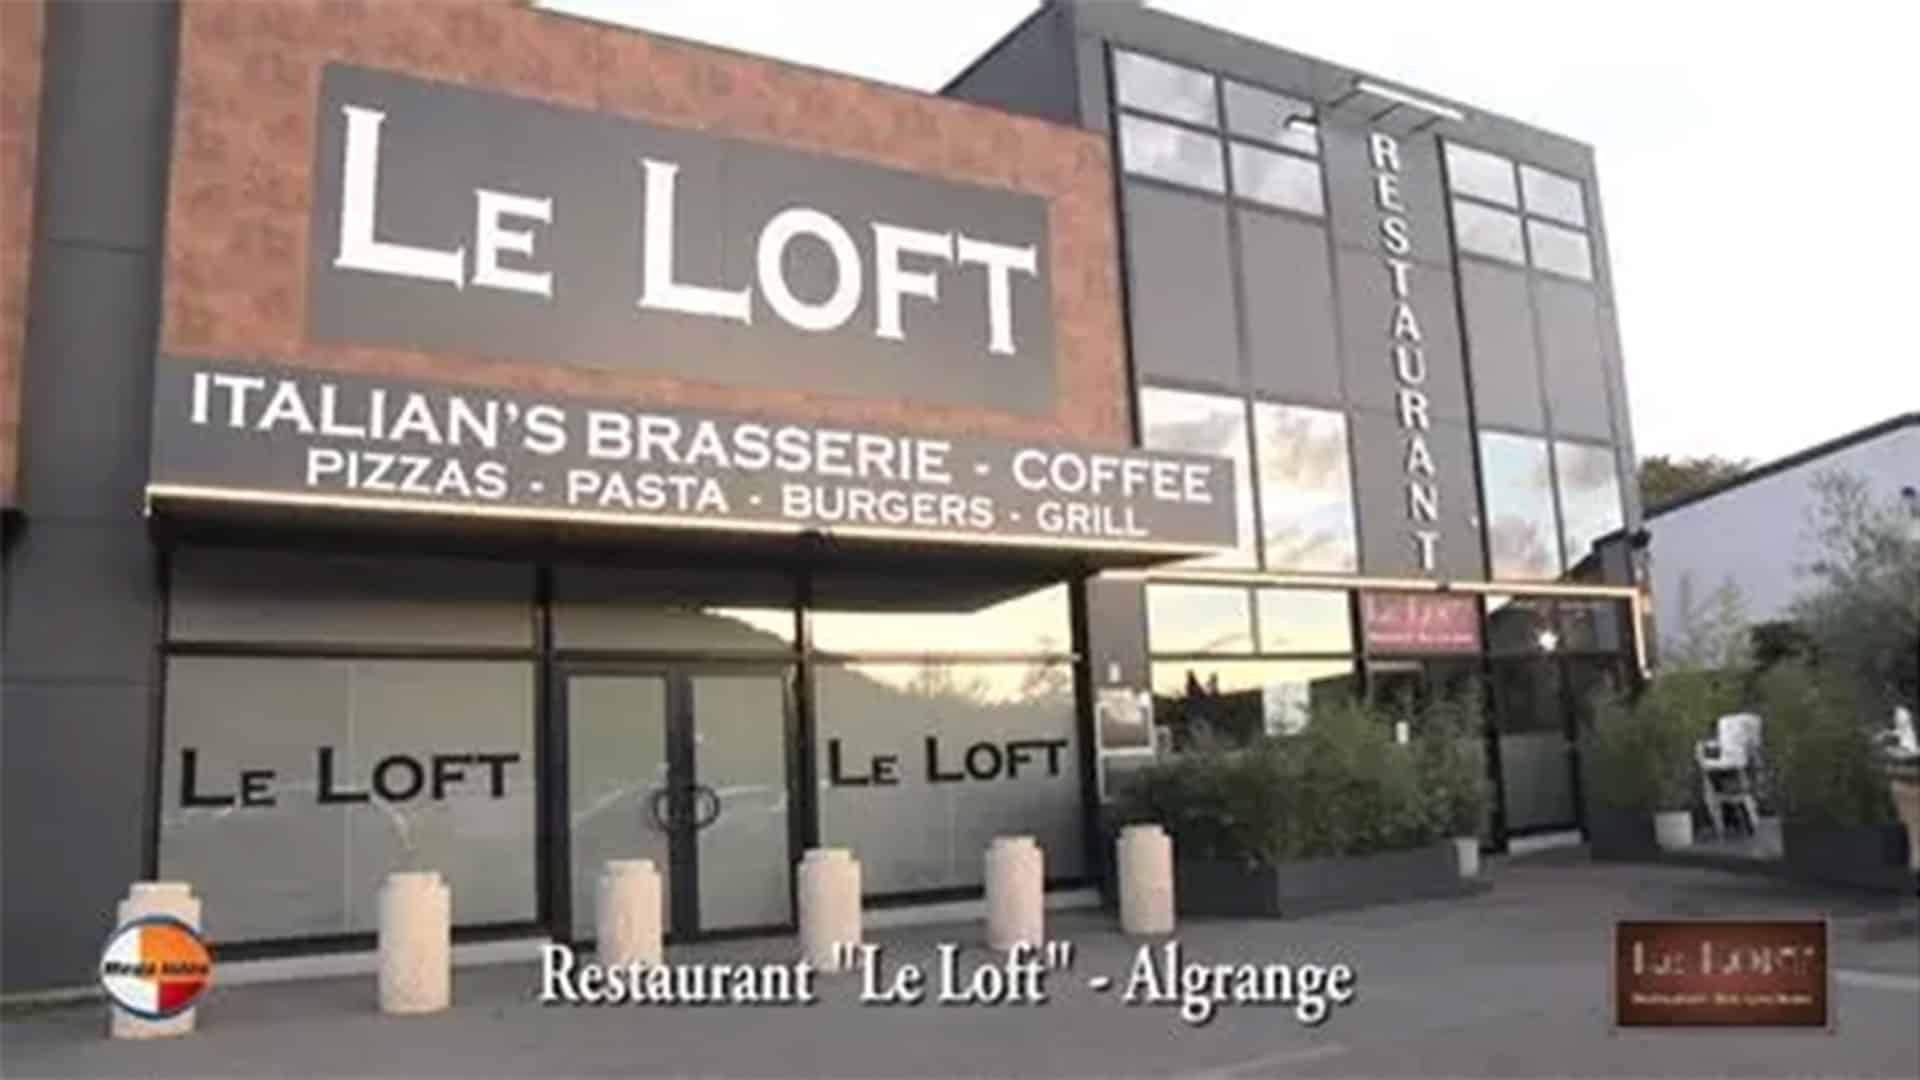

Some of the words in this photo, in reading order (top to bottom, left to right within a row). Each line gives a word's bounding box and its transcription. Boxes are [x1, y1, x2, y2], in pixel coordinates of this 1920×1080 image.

[637, 157, 1038, 357] LOFT
[1370, 131, 1440, 571] RESTAURANT
[190, 372, 568, 455] ITALIAN'S
[586, 409, 954, 486] BRASSERIE
[1010, 447, 1214, 505] COFFEE
[306, 448, 508, 500] PIZZAS
[566, 468, 731, 515] PASTA
[780, 482, 996, 530] BURGERS
[1035, 499, 1150, 539] GRILL
[315, 745, 521, 806] LOFT
[924, 735, 1070, 785] LOFT
